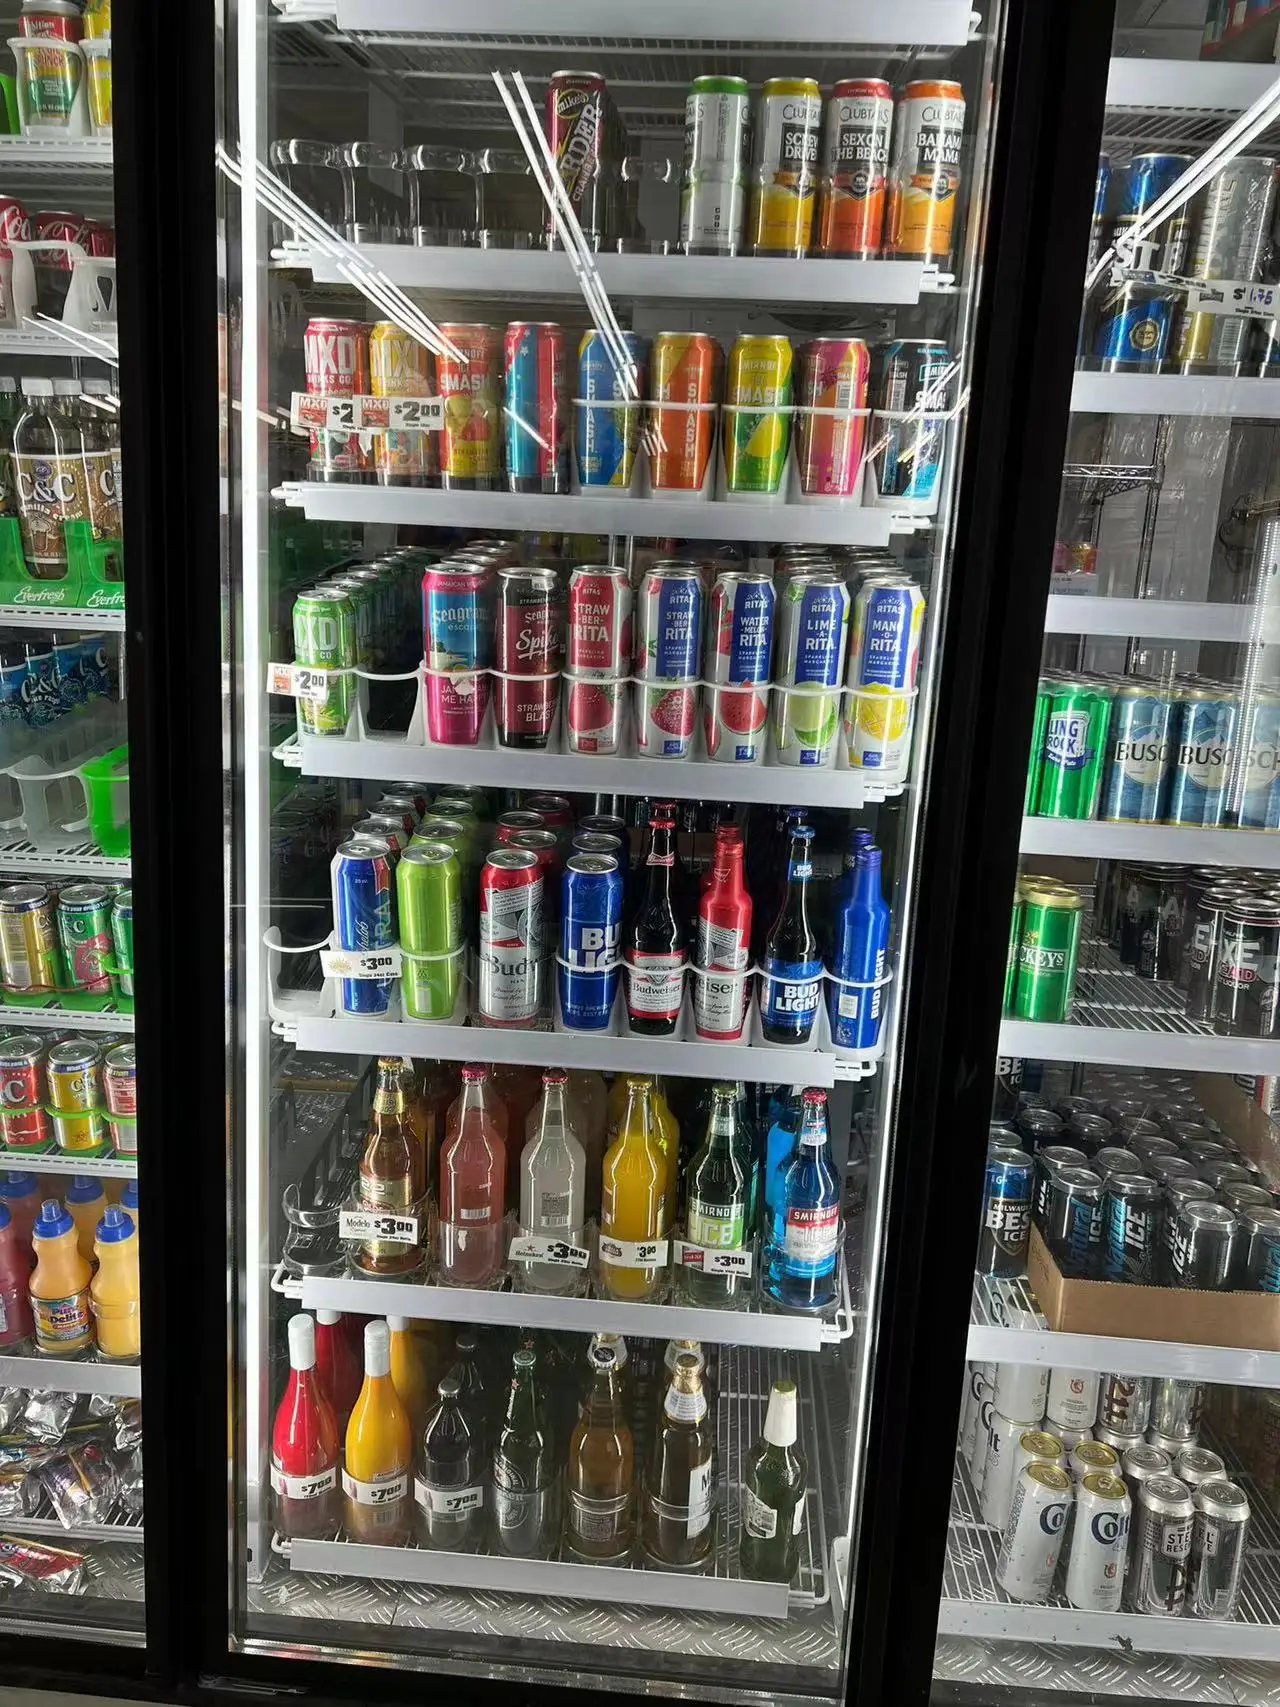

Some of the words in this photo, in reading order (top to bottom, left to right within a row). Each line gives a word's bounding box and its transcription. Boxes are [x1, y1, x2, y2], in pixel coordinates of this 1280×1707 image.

[842, 133, 866, 147] SEX
[867, 134, 884, 148] ON
[855, 148, 888, 164] BEACH
[304, 335, 356, 375] MXD
[732, 386, 784, 405] SMASH
[17, 471, 76, 503] C&C
[14, 585, 66, 604] Everfresh
[669, 595, 694, 605] RITAS
[574, 602, 611, 615] STRAW
[744, 599, 769, 609] RITAS
[811, 603, 836, 614] RITAS
[876, 604, 905, 614] RITAS
[666, 610, 695, 621] STRAW
[740, 615, 770, 627] WATER
[806, 619, 837, 632] LIME
[574, 625, 611, 643] RITA
[664, 627, 694, 642] RITA
[739, 633, 768, 648] RITA
[805, 637, 837, 652] RITA
[870, 637, 902, 653] RITA
[441, 695, 457, 704] ME
[632, 983, 682, 997] Budweiser
[784, 983, 819, 999] BUD
[775, 995, 820, 1012] LIGHT
[870, 991, 882, 1020] BUD
[793, 1206, 839, 1222] SMIRNOFF
[1089, 1207, 1102, 1243] ICE
[1125, 1205, 1146, 1250] ICE
[1003, 1230, 1028, 1242] ICE
[1172, 1229, 1188, 1275] ICE
